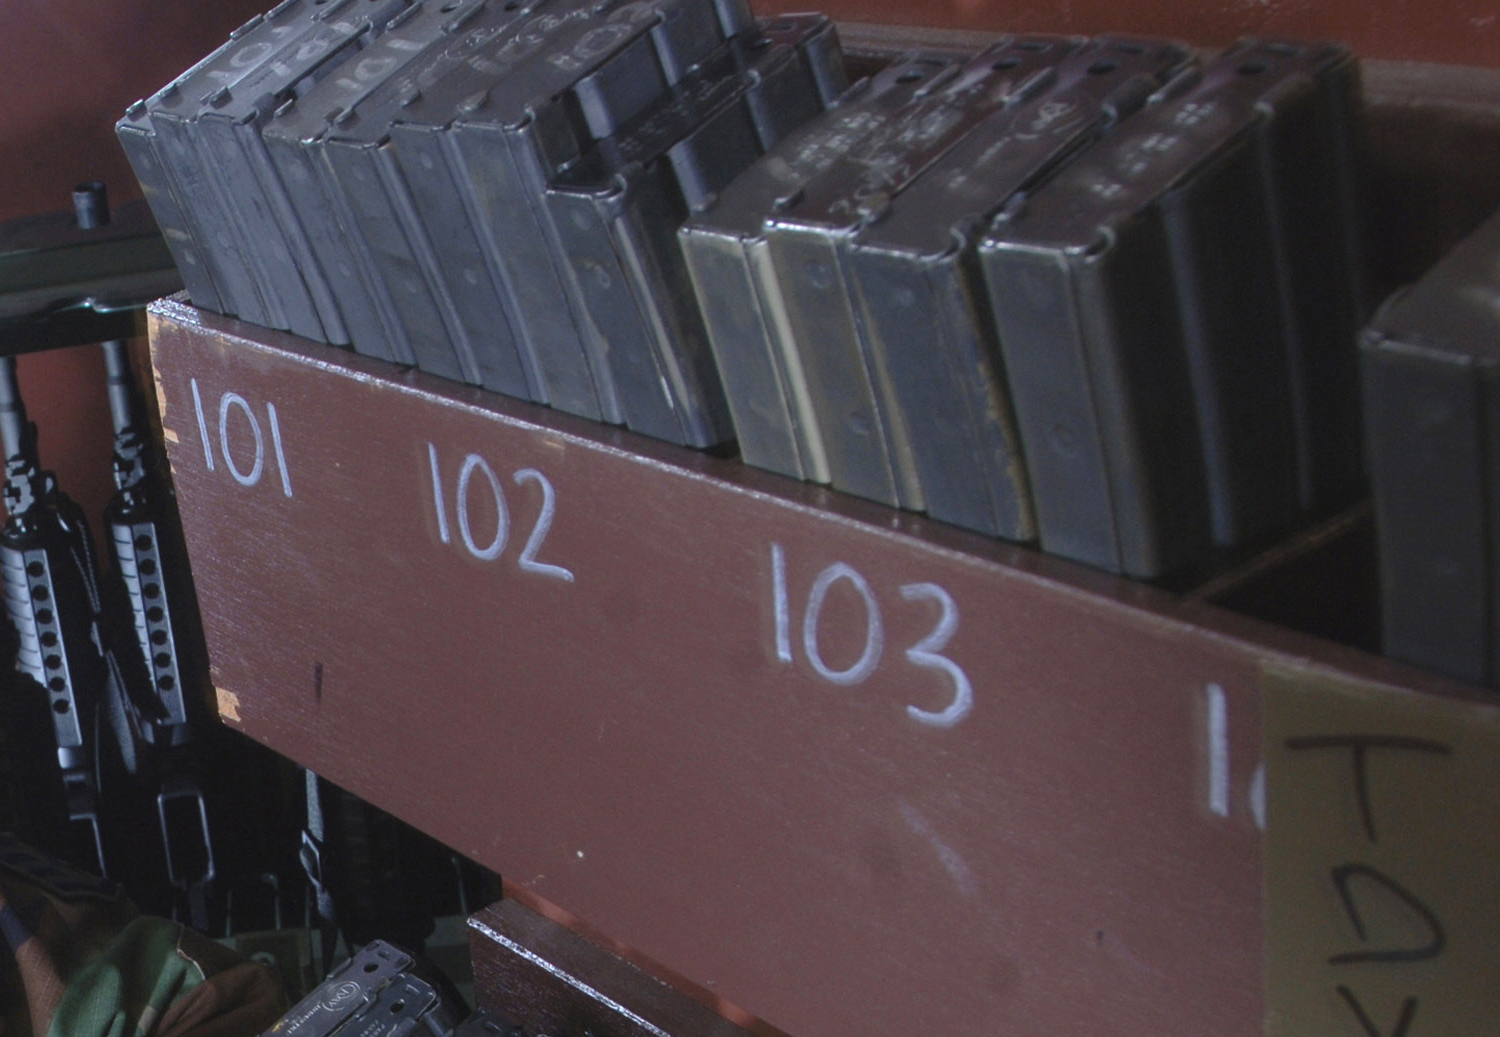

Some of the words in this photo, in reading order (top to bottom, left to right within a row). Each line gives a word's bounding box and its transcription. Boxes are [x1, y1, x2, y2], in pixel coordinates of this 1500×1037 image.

[191, 378, 293, 498] 101
[428, 443, 574, 582] 102
[770, 541, 972, 729] 103
